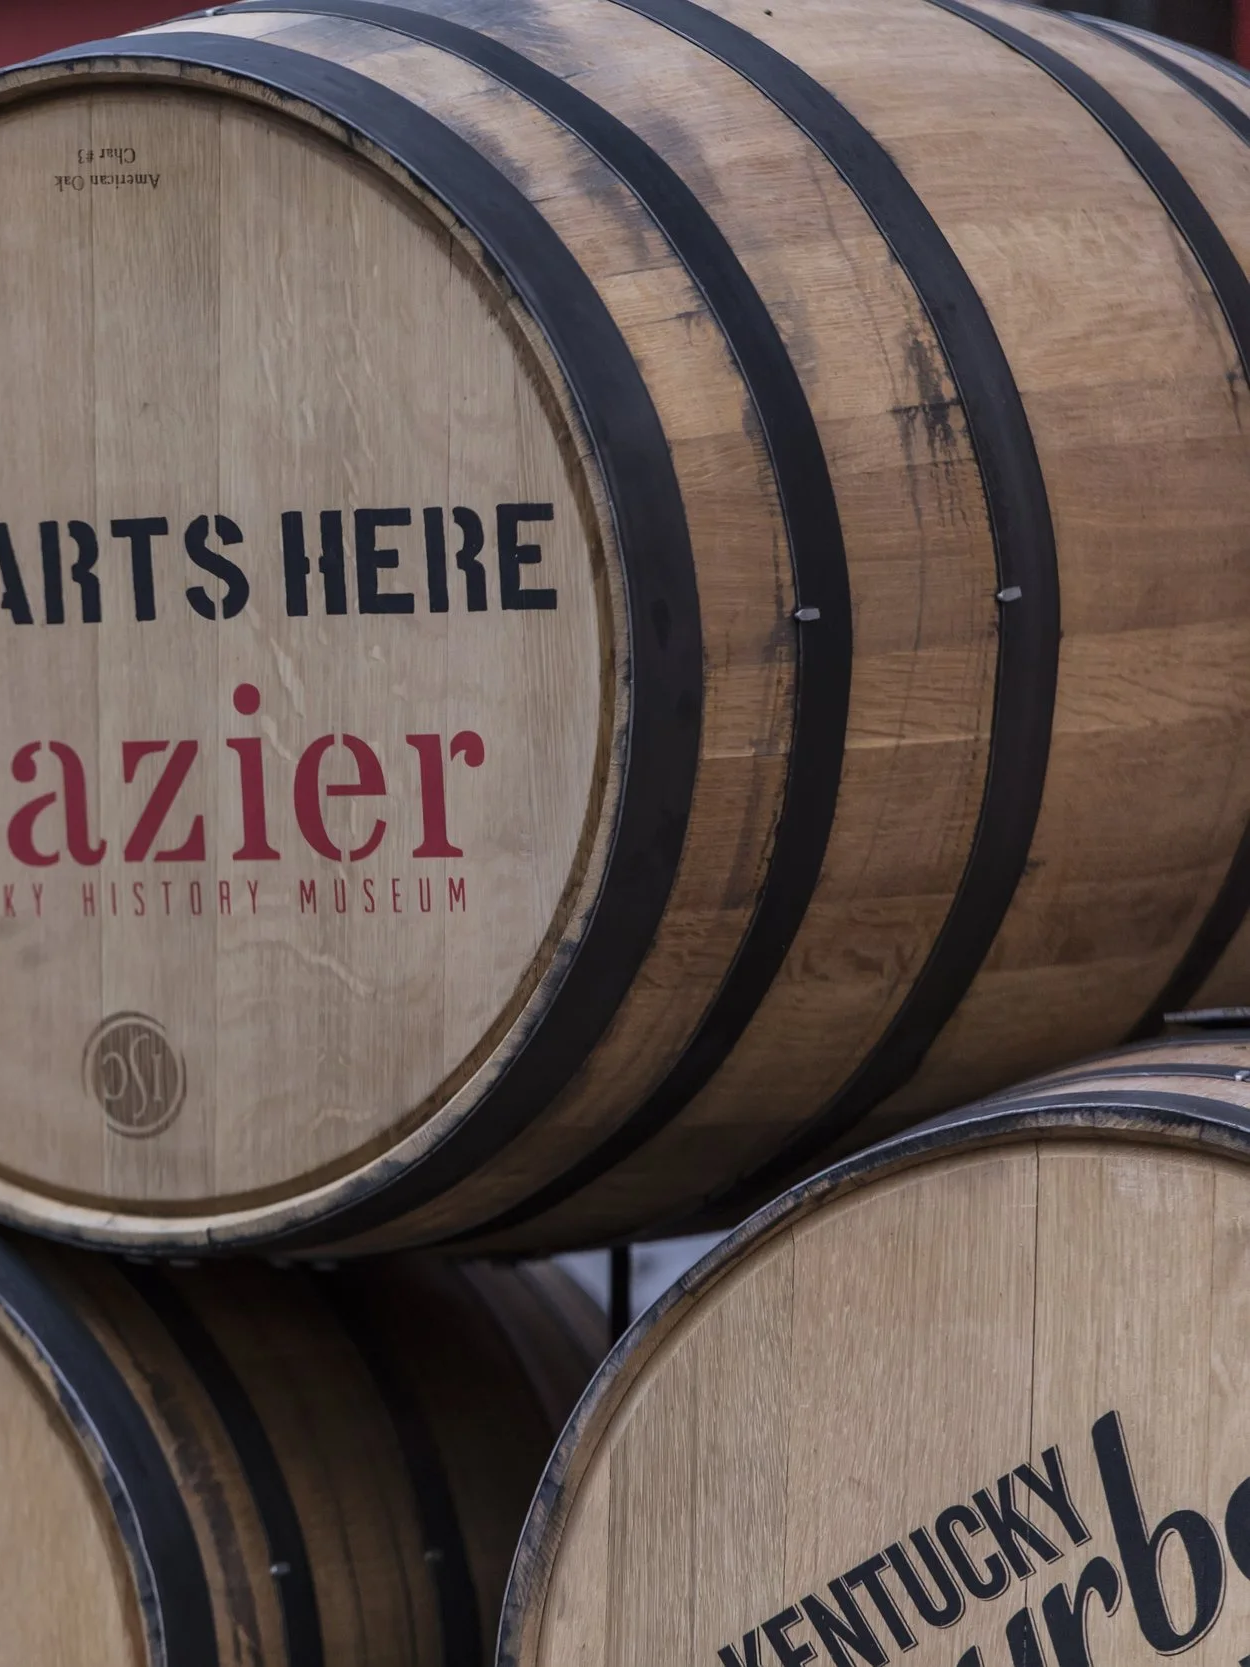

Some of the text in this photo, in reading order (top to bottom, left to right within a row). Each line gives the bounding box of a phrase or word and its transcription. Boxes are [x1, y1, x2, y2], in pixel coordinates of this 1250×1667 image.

[77, 147, 136, 165] Char #3
[54, 173, 161, 192] American Oak
[281, 502, 558, 617] HERE
[82, 879, 260, 917] HISTORY
[299, 877, 467, 914] MUSEUM
